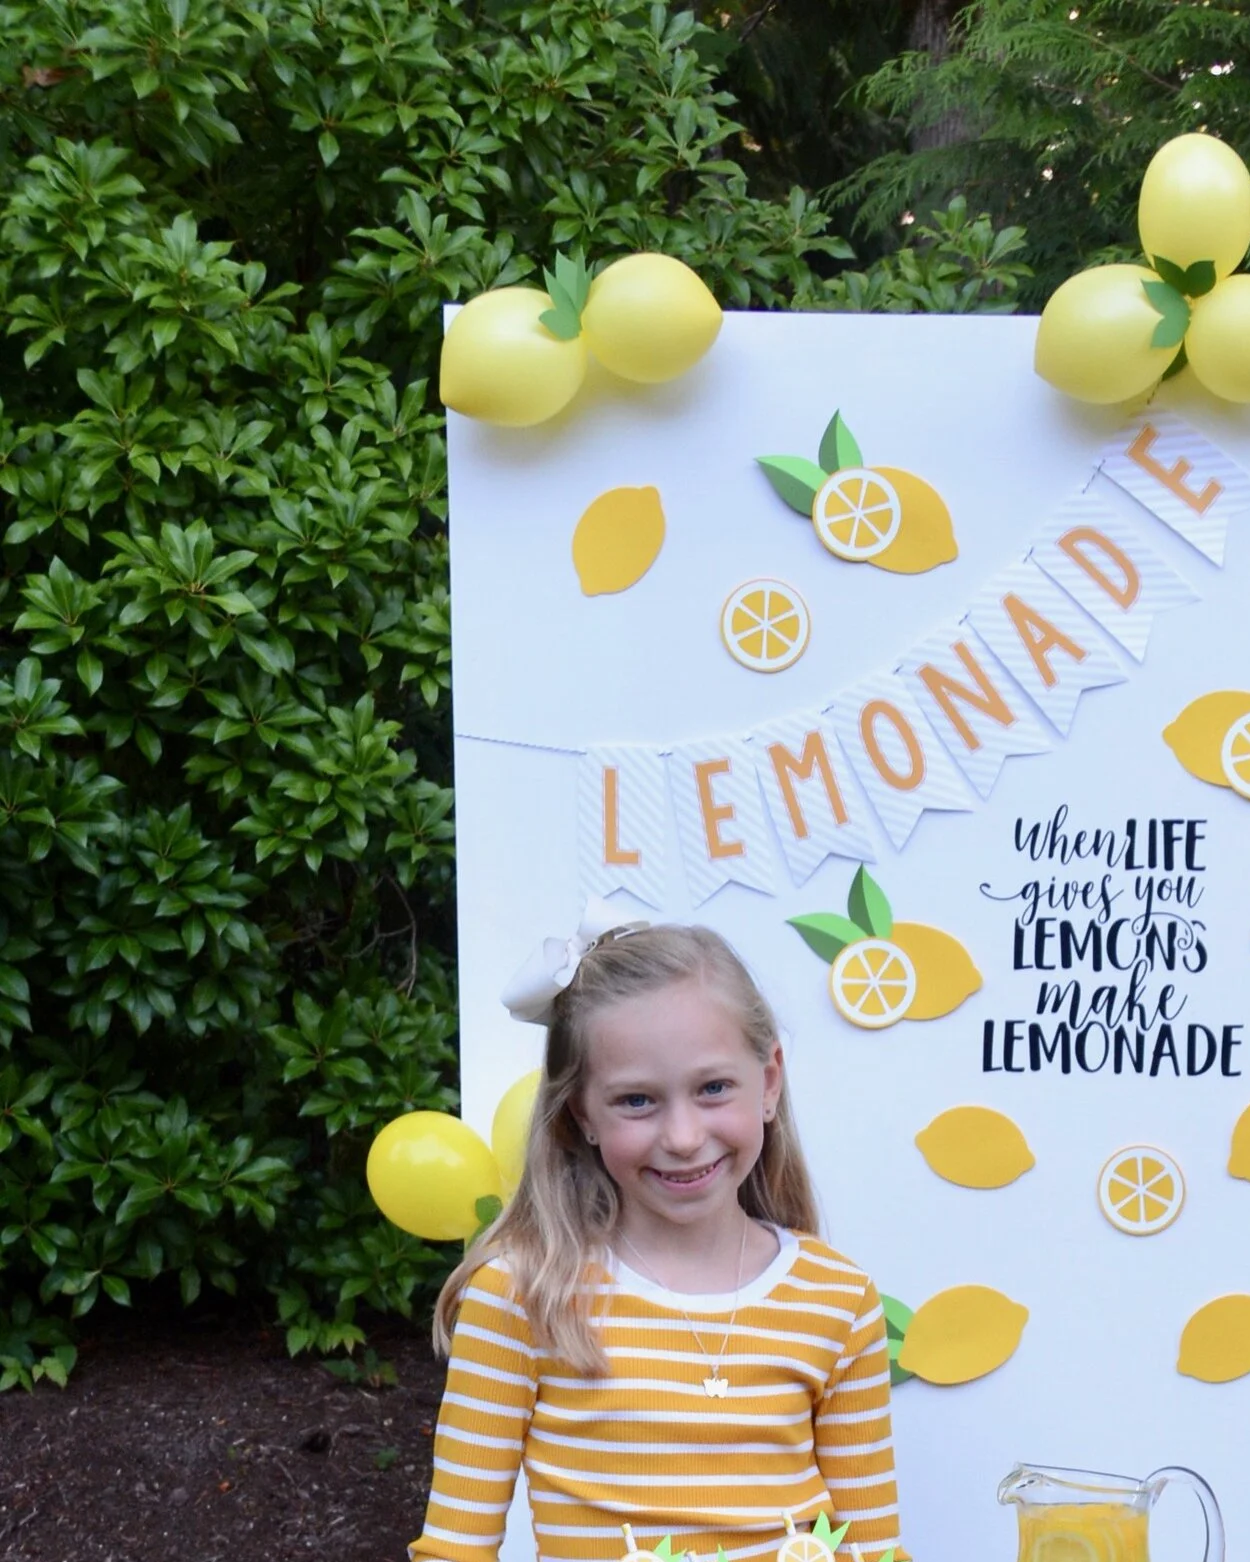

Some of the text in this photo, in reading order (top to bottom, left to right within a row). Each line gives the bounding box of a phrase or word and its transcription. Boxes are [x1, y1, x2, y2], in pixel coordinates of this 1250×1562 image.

[602, 422, 1227, 868] LEMONADE
[1125, 818, 1207, 871] LIFE
[979, 874, 1205, 940] gives you
[1013, 917, 1208, 973] LEMONS
[1036, 959, 1188, 1031] make
[982, 1019, 1245, 1077] LEMONADE
